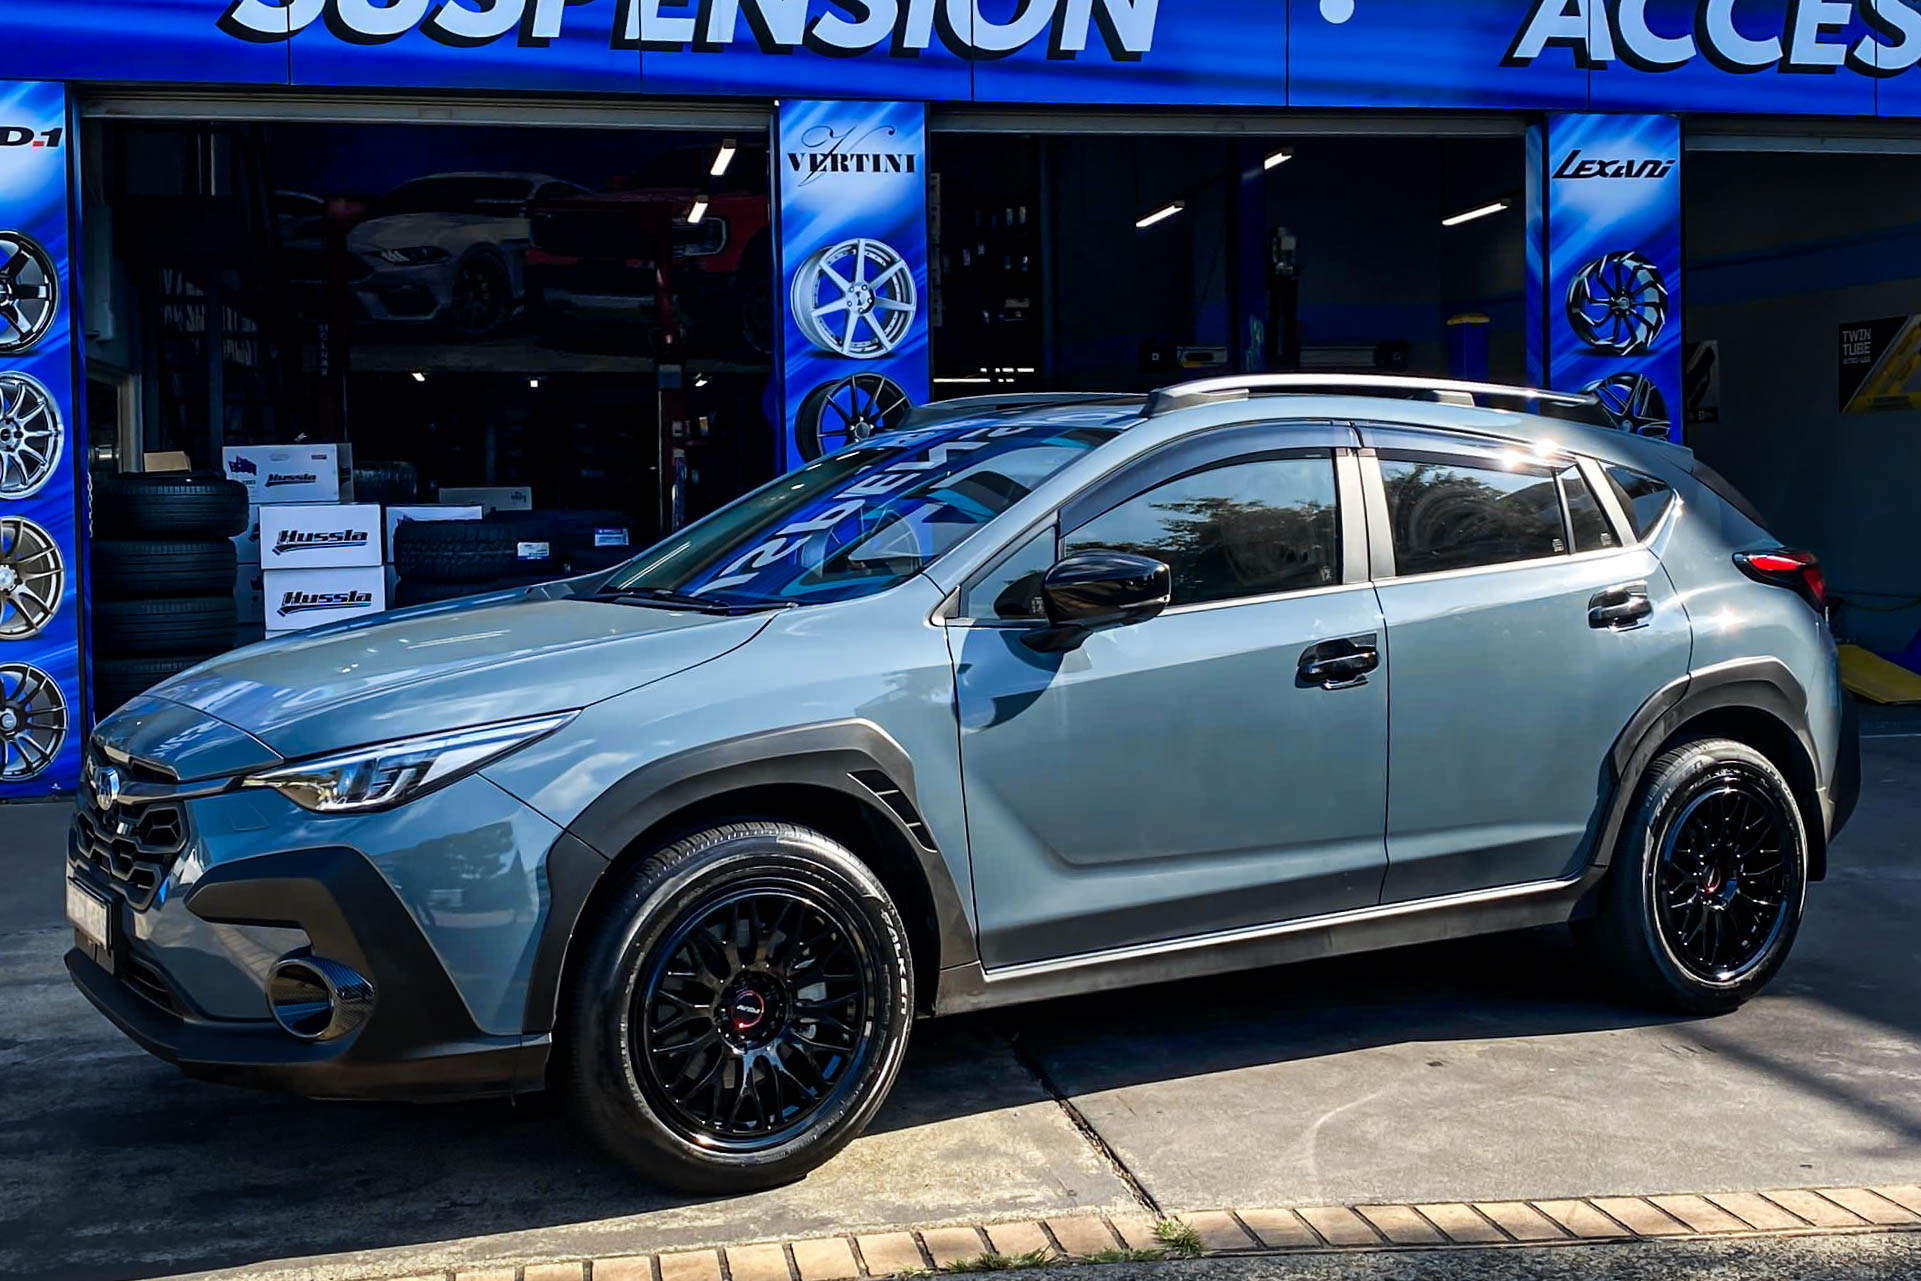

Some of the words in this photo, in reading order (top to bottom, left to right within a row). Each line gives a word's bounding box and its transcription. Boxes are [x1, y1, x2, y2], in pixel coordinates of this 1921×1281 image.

[787, 152, 915, 173] VERTINI
[1842, 328, 1872, 342] TWIN
[1842, 341, 1871, 356] TUBE
[267, 473, 317, 483] Hussla
[277, 529, 368, 546] Hussla
[281, 590, 372, 607] Hussla
